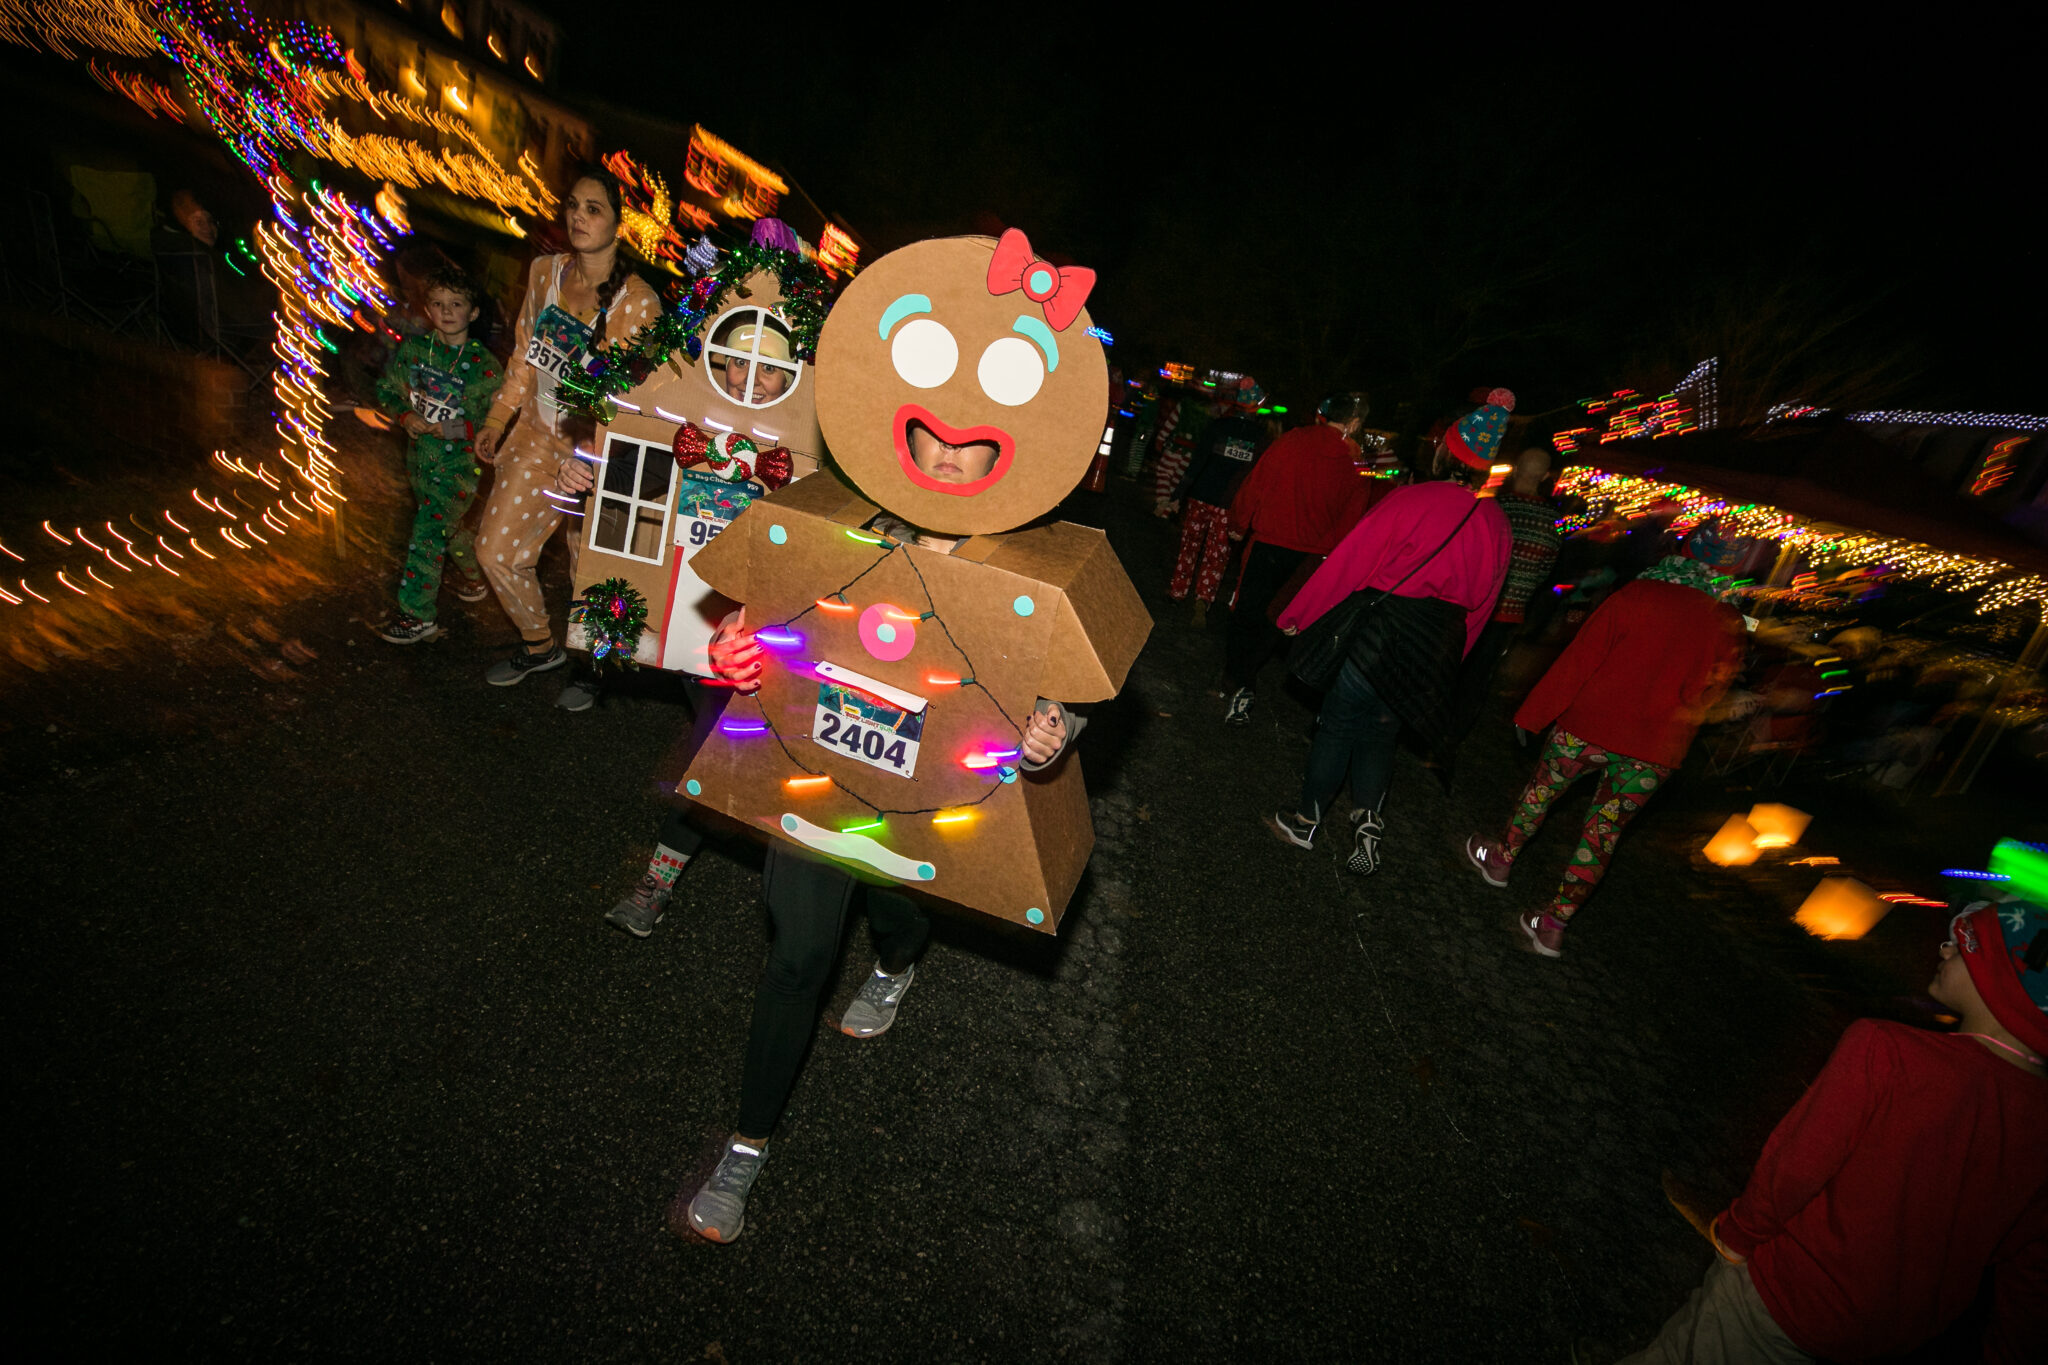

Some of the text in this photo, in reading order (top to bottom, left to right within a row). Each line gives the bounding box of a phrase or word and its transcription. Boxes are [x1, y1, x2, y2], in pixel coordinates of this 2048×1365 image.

[529, 340, 570, 379] 3576
[415, 395, 451, 422] 3578
[1227, 448, 1250, 459] 4382
[695, 474, 733, 485] Bag Che
[820, 713, 907, 768] 2404
[1476, 846, 1488, 862] N
[1531, 916, 1540, 928] N
